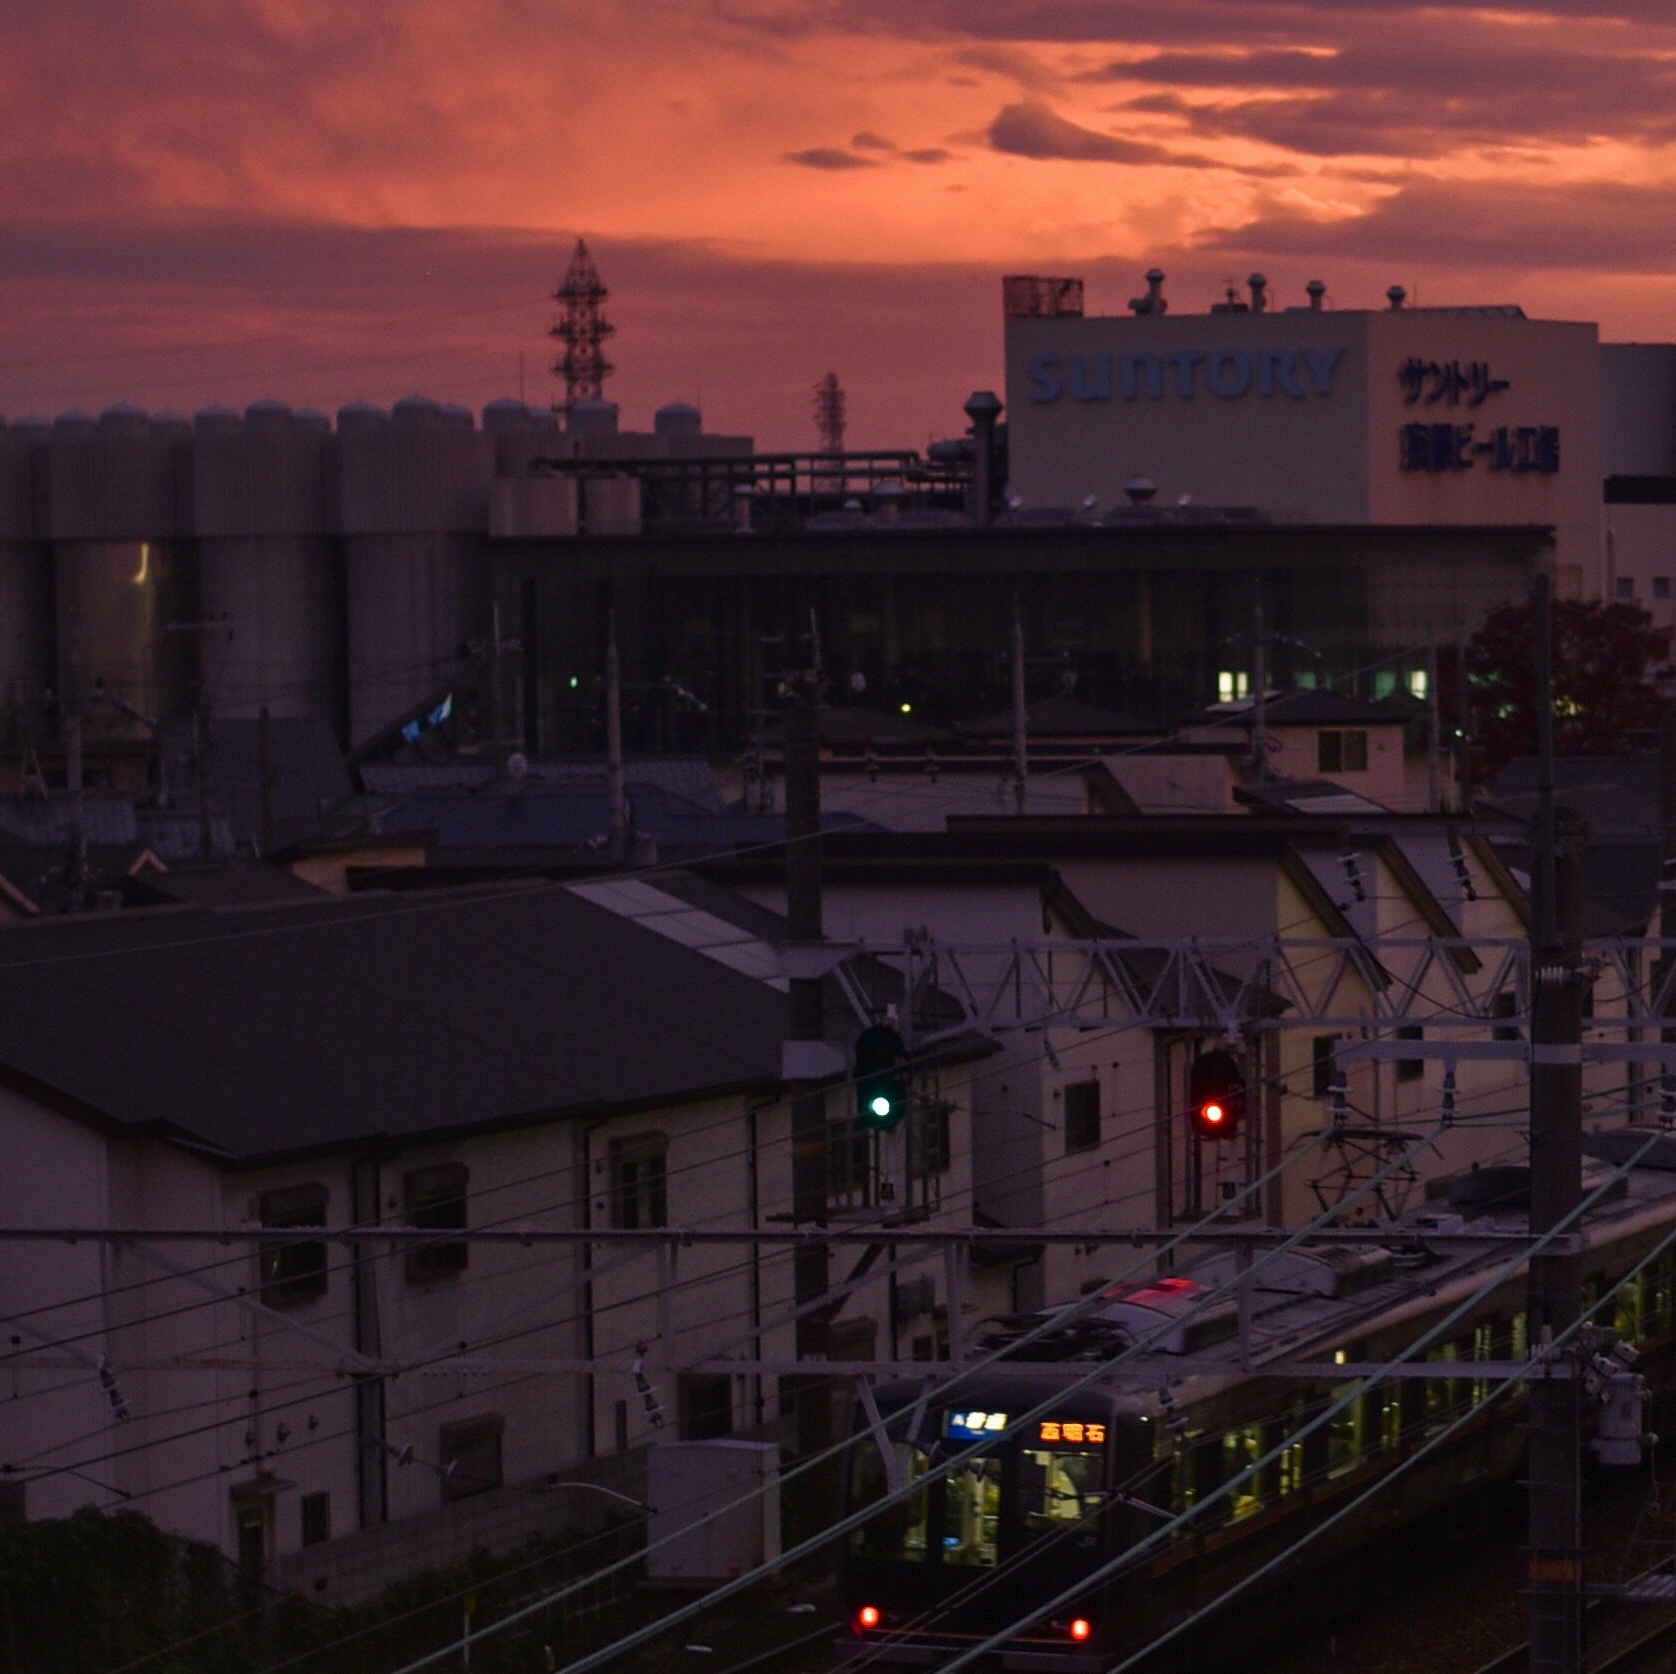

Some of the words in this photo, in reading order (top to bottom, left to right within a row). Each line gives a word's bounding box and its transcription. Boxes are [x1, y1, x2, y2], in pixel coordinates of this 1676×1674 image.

[1027, 346, 1347, 402] SUNTORY
[1399, 358, 1510, 406] サントリー
